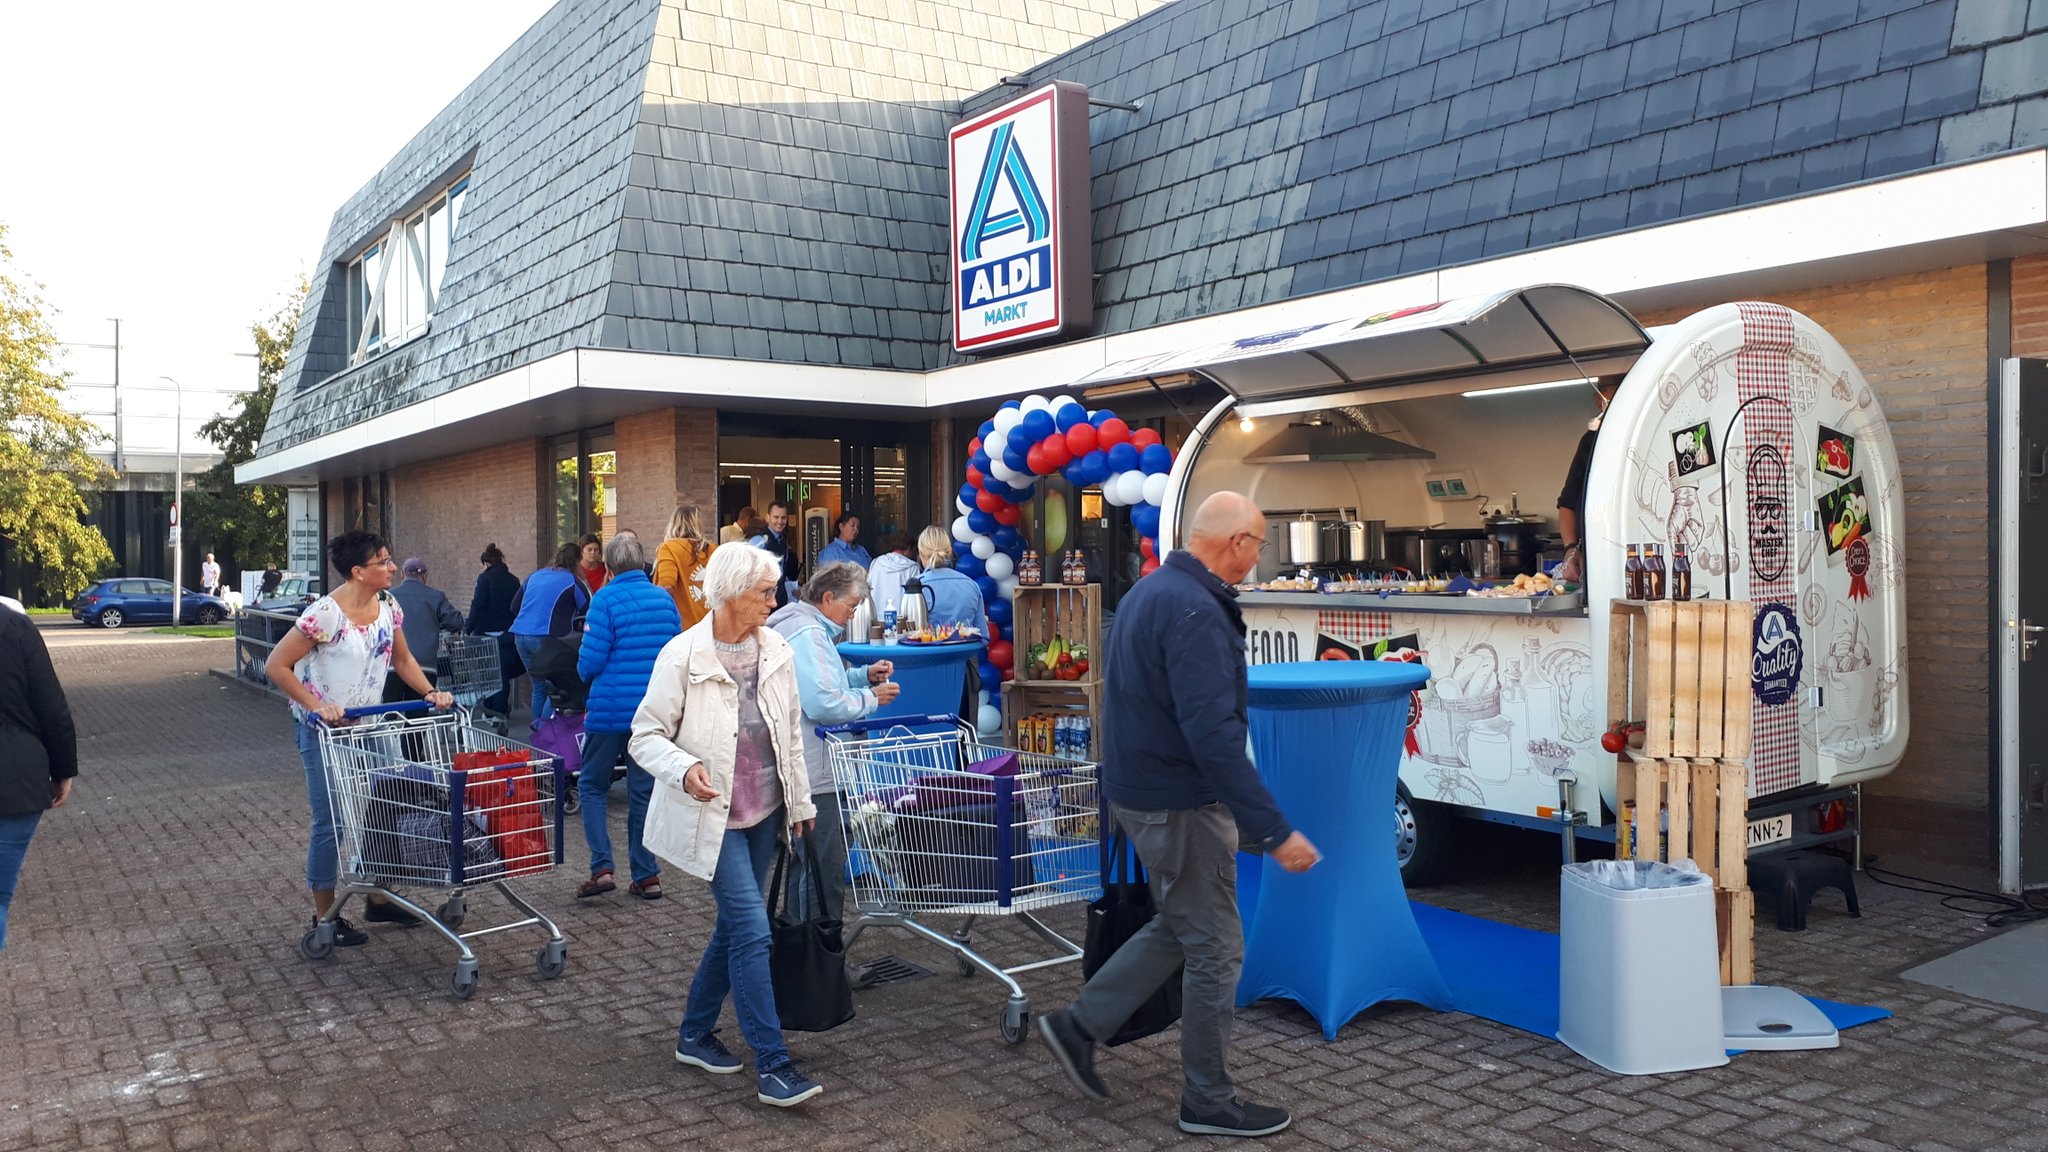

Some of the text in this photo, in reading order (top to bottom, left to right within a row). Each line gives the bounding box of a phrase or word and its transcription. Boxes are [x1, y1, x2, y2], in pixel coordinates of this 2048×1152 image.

[969, 252, 1041, 305] ALDI
[984, 301, 1028, 327] MARKT
[1755, 538, 1783, 548] MASTER
[1761, 549, 1778, 558] CHEF
[1751, 642, 1797, 683] Quality
[1763, 677, 1788, 691] GUARANTEED
